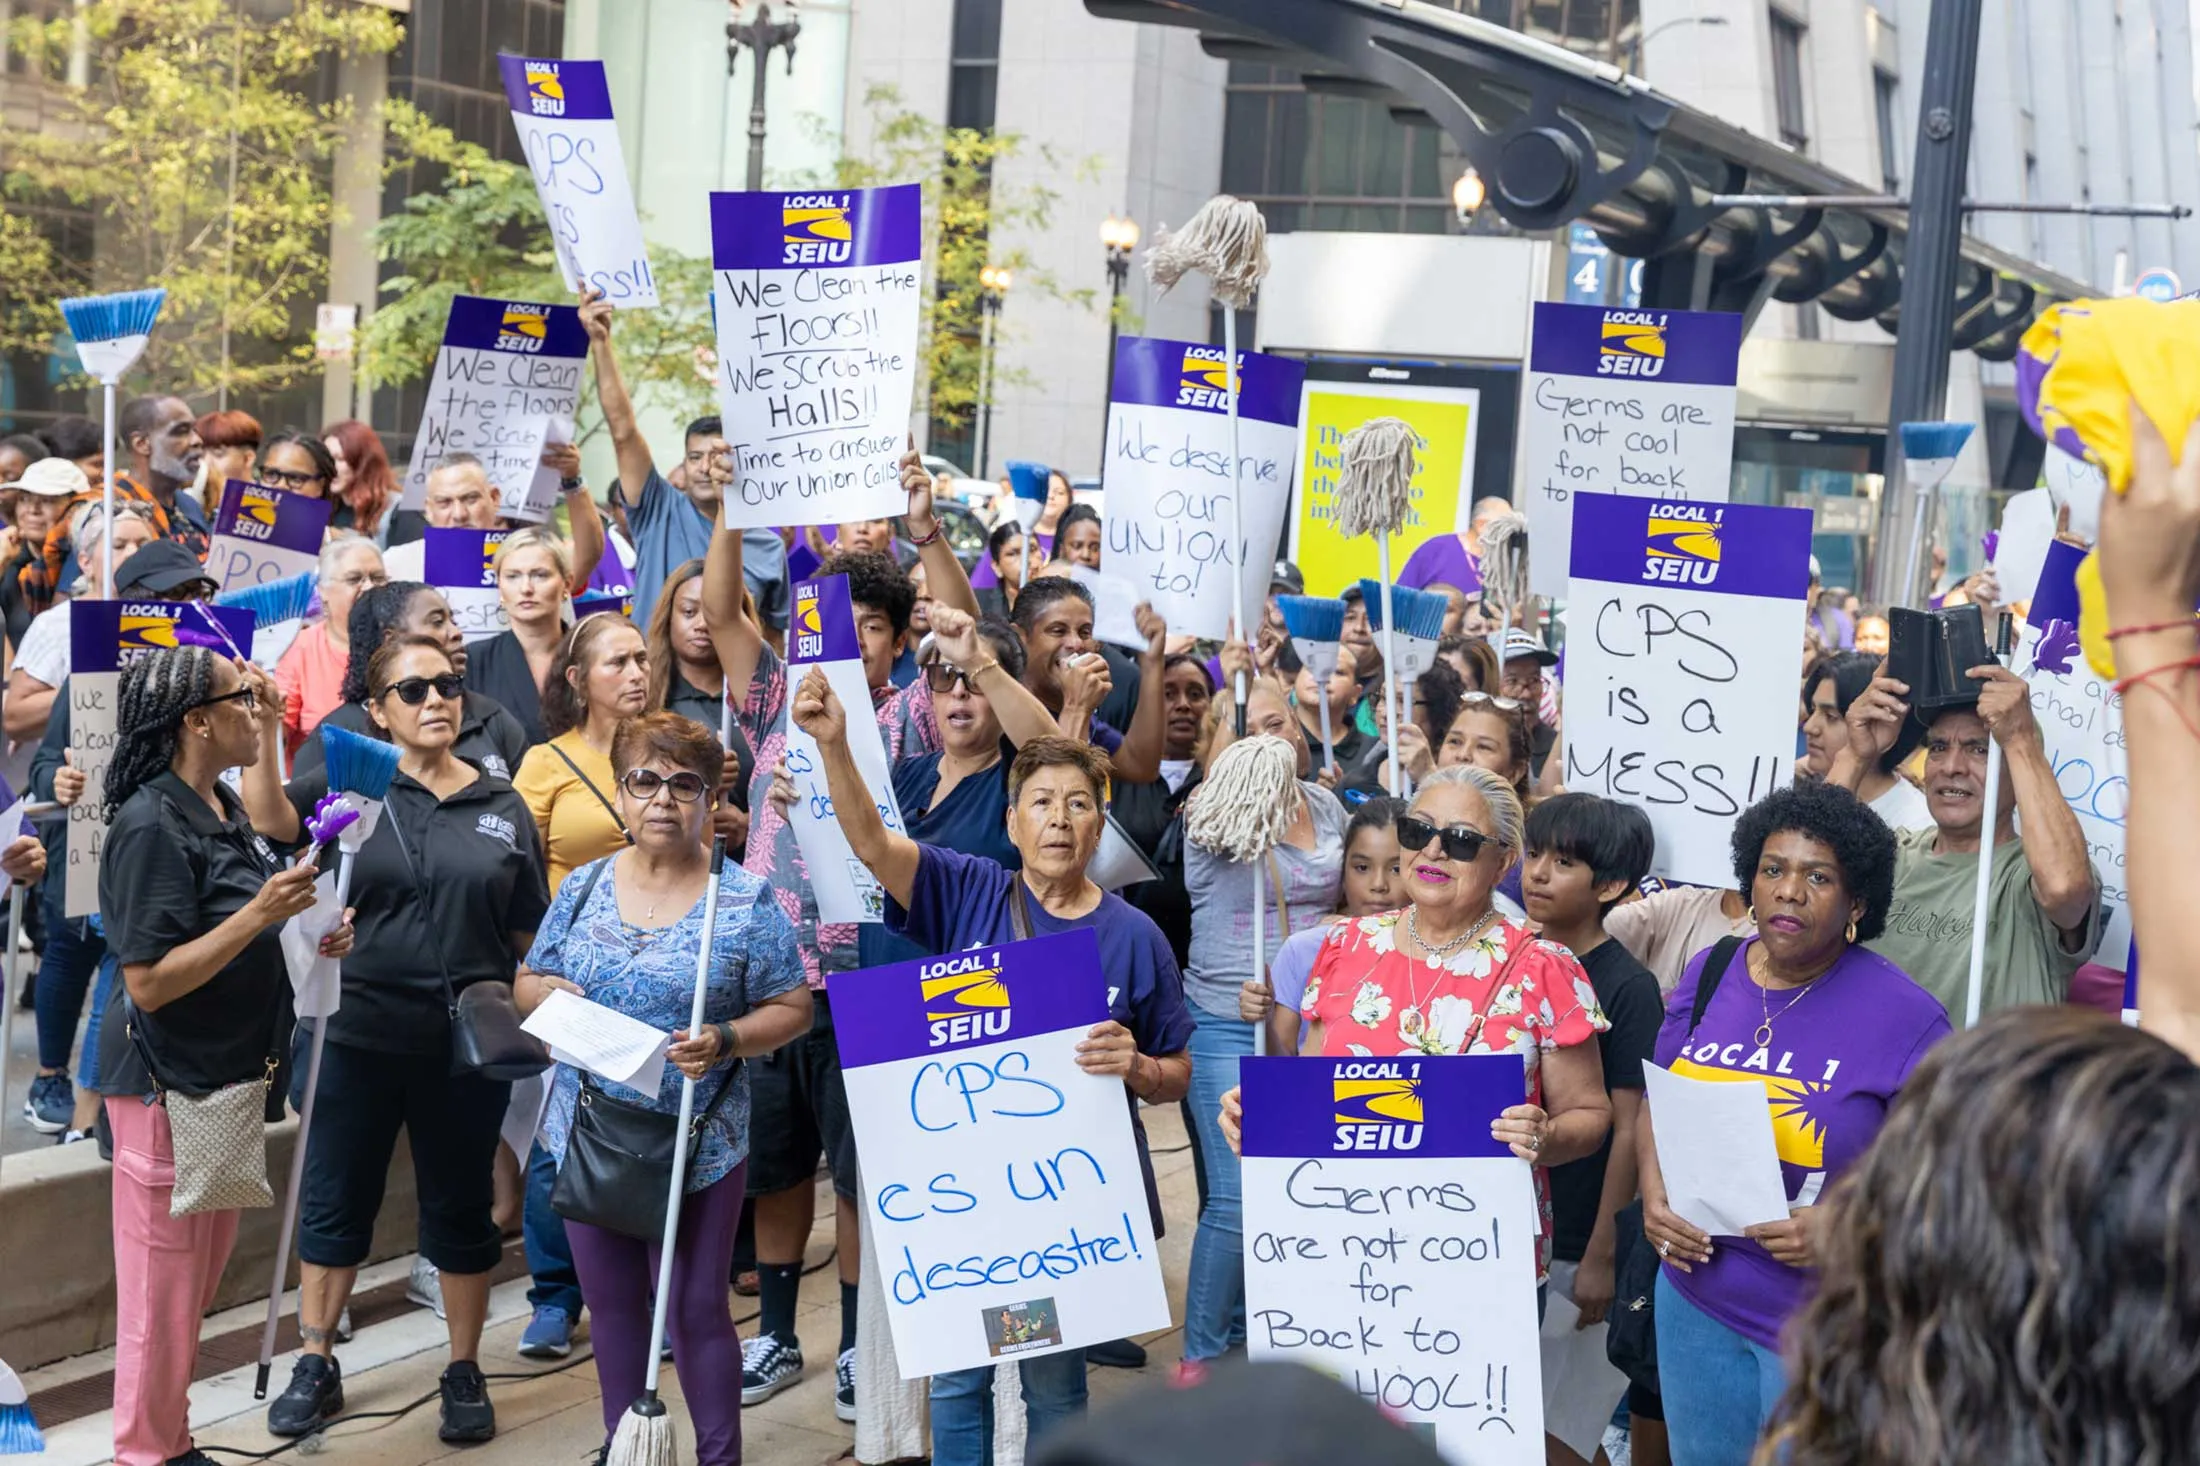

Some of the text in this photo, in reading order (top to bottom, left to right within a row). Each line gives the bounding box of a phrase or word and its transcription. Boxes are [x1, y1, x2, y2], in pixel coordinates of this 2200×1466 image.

[525, 62, 551, 73] LOCAL
[532, 98, 565, 116] SEIU
[528, 128, 604, 195] CPS
[783, 195, 850, 208] LOCAL 1
[783, 242, 851, 264] SEIU
[724, 268, 915, 308] We Clean the
[1573, 258, 1600, 293] 4
[505, 303, 551, 317] LOCAL 1
[1603, 311, 1667, 326] LOCAL 1
[494, 336, 544, 352] SEIU
[447, 350, 579, 388] We Clean
[727, 356, 774, 394] We
[865, 351, 903, 375] the
[1597, 355, 1664, 377] SEIU
[440, 387, 575, 419] the floors
[1536, 378, 1711, 425] Germs are
[428, 416, 465, 448] We
[1119, 416, 1159, 463] We
[1564, 422, 1677, 455] not cool
[487, 450, 533, 469] time
[733, 436, 897, 471] Time to answer
[1555, 450, 1685, 488] for back
[244, 486, 272, 499] LOCAL
[742, 478, 788, 505] Our
[797, 471, 857, 497] Union
[1543, 478, 1568, 501] to
[1155, 490, 1232, 520] our
[1649, 504, 1724, 523] LOCAL 1
[232, 519, 273, 540] SEIU
[1151, 561, 1202, 598] to!
[1642, 558, 1719, 584] SEIU
[797, 585, 814, 600] LOCAL
[121, 604, 182, 619] LOCAL 1
[797, 634, 823, 658] SEIU
[1596, 598, 1738, 682] CPS
[1607, 676, 1721, 734] is a
[920, 951, 1000, 980] LOCAL 1
[929, 1008, 1011, 1047] SEIU
[1334, 1063, 1420, 1079] LOCAL 1
[1822, 1059, 1840, 1081] 1
[911, 1051, 1065, 1131] CPS
[1334, 1124, 1423, 1150] SEIU
[878, 1148, 1106, 1221] es un
[1287, 1159, 1476, 1214] Germs
[1253, 1217, 1500, 1263] are not cool
[893, 1211, 1142, 1304] deseastre!
[1350, 1262, 1412, 1307] for
[1254, 1310, 1460, 1355] Back to
